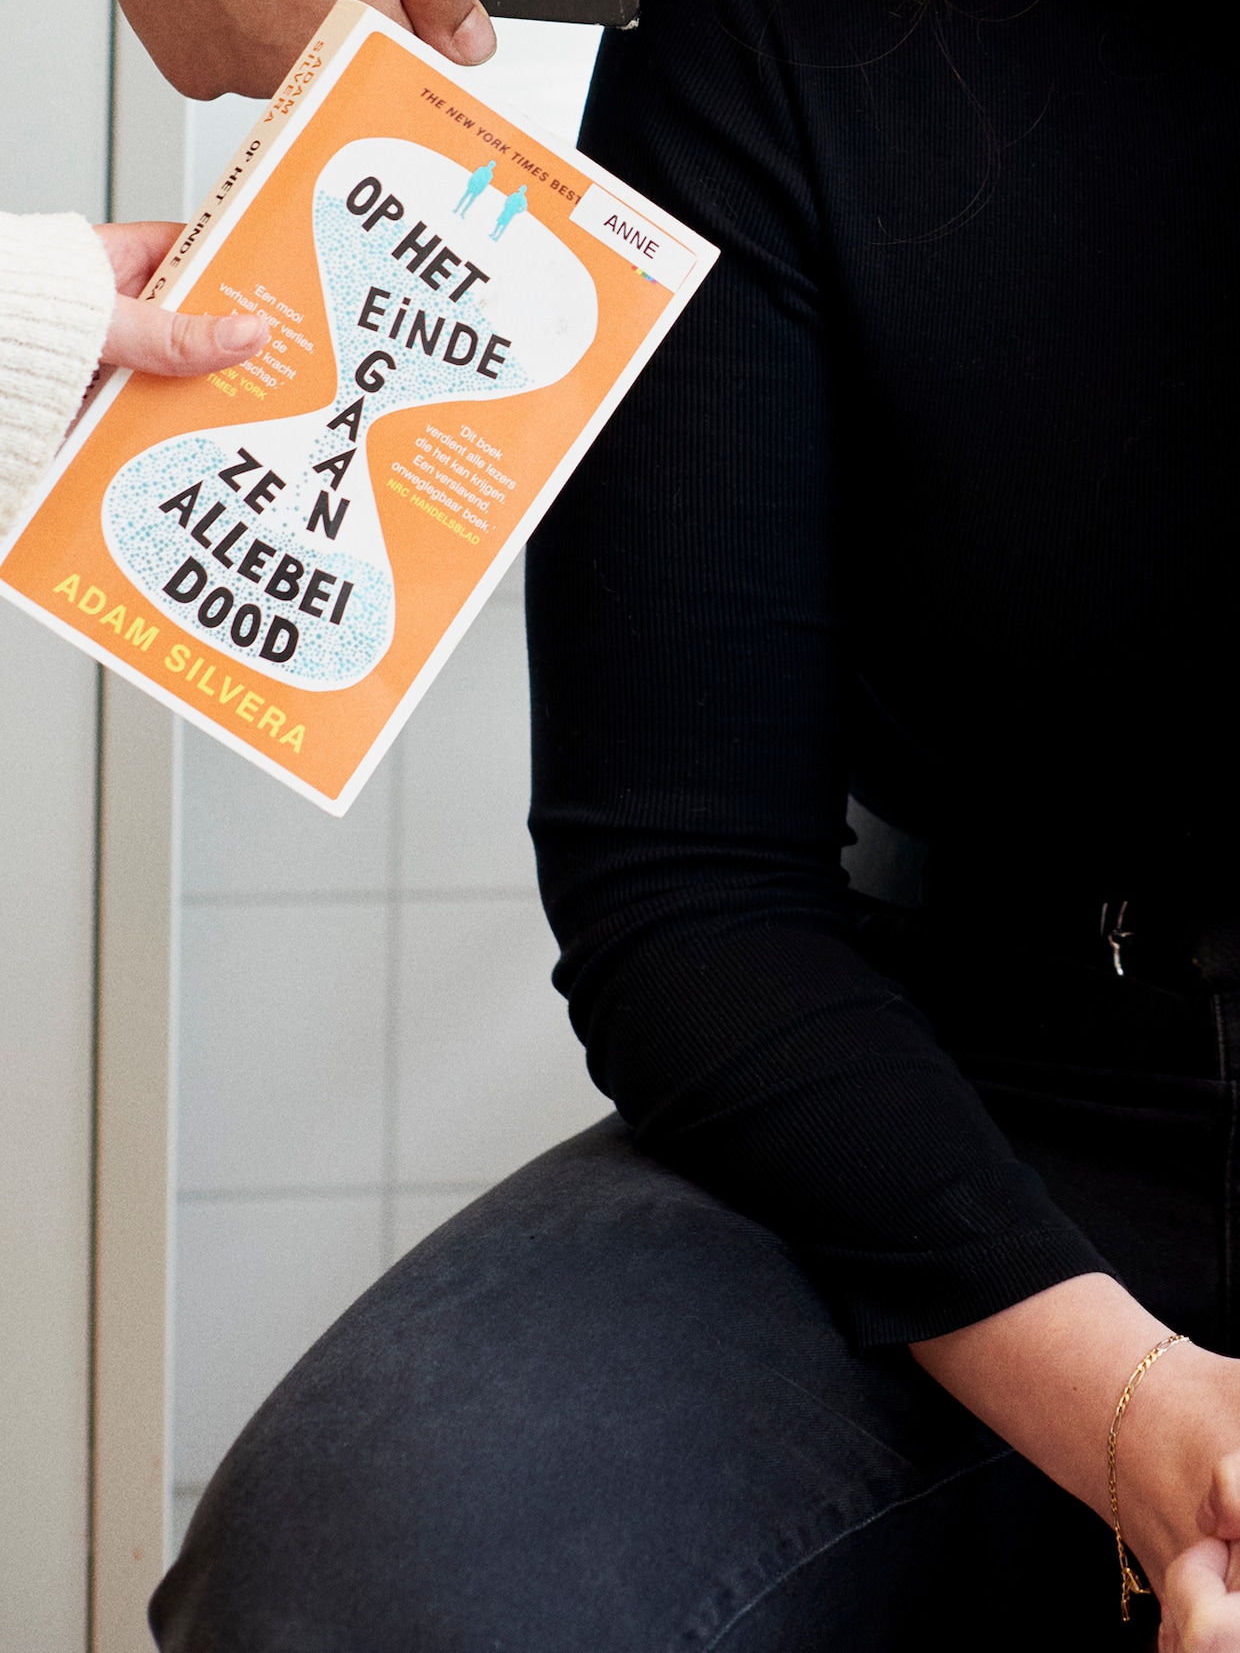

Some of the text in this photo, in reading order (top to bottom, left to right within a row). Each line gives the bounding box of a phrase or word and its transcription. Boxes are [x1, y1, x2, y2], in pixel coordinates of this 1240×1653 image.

[263, 39, 325, 123] SILVERA
[281, 57, 323, 115] ADAM
[245, 139, 261, 163] OP
[420, 88, 446, 110] THE
[445, 106, 475, 129] NEW
[476, 127, 511, 155] YORK
[511, 152, 549, 182] TIMES
[215, 166, 243, 206] HET
[169, 212, 212, 269] EINDE
[345, 176, 491, 303] OP HET
[603, 214, 660, 259] ANNE
[219, 282, 315, 355] verhaal over verlies,
[276, 301, 305, 324] mooi
[262, 351, 297, 380] kracht
[272, 338, 288, 353] de
[206, 372, 239, 398] TIMES
[239, 376, 268, 401] YORK
[414, 436, 506, 505] die het kan krijgen.
[425, 423, 517, 491] verdient alle lezers
[476, 437, 504, 461] boek
[217, 447, 287, 515] ZE
[391, 461, 463, 513] onweglegbaar
[412, 453, 490, 515] Een verslavend,
[386, 477, 481, 546] NRC HANDELSBLAD
[158, 480, 354, 625] ALLEBEI
[162, 555, 300, 663] DOOD
[53, 573, 307, 754] ADAM SILVERA
